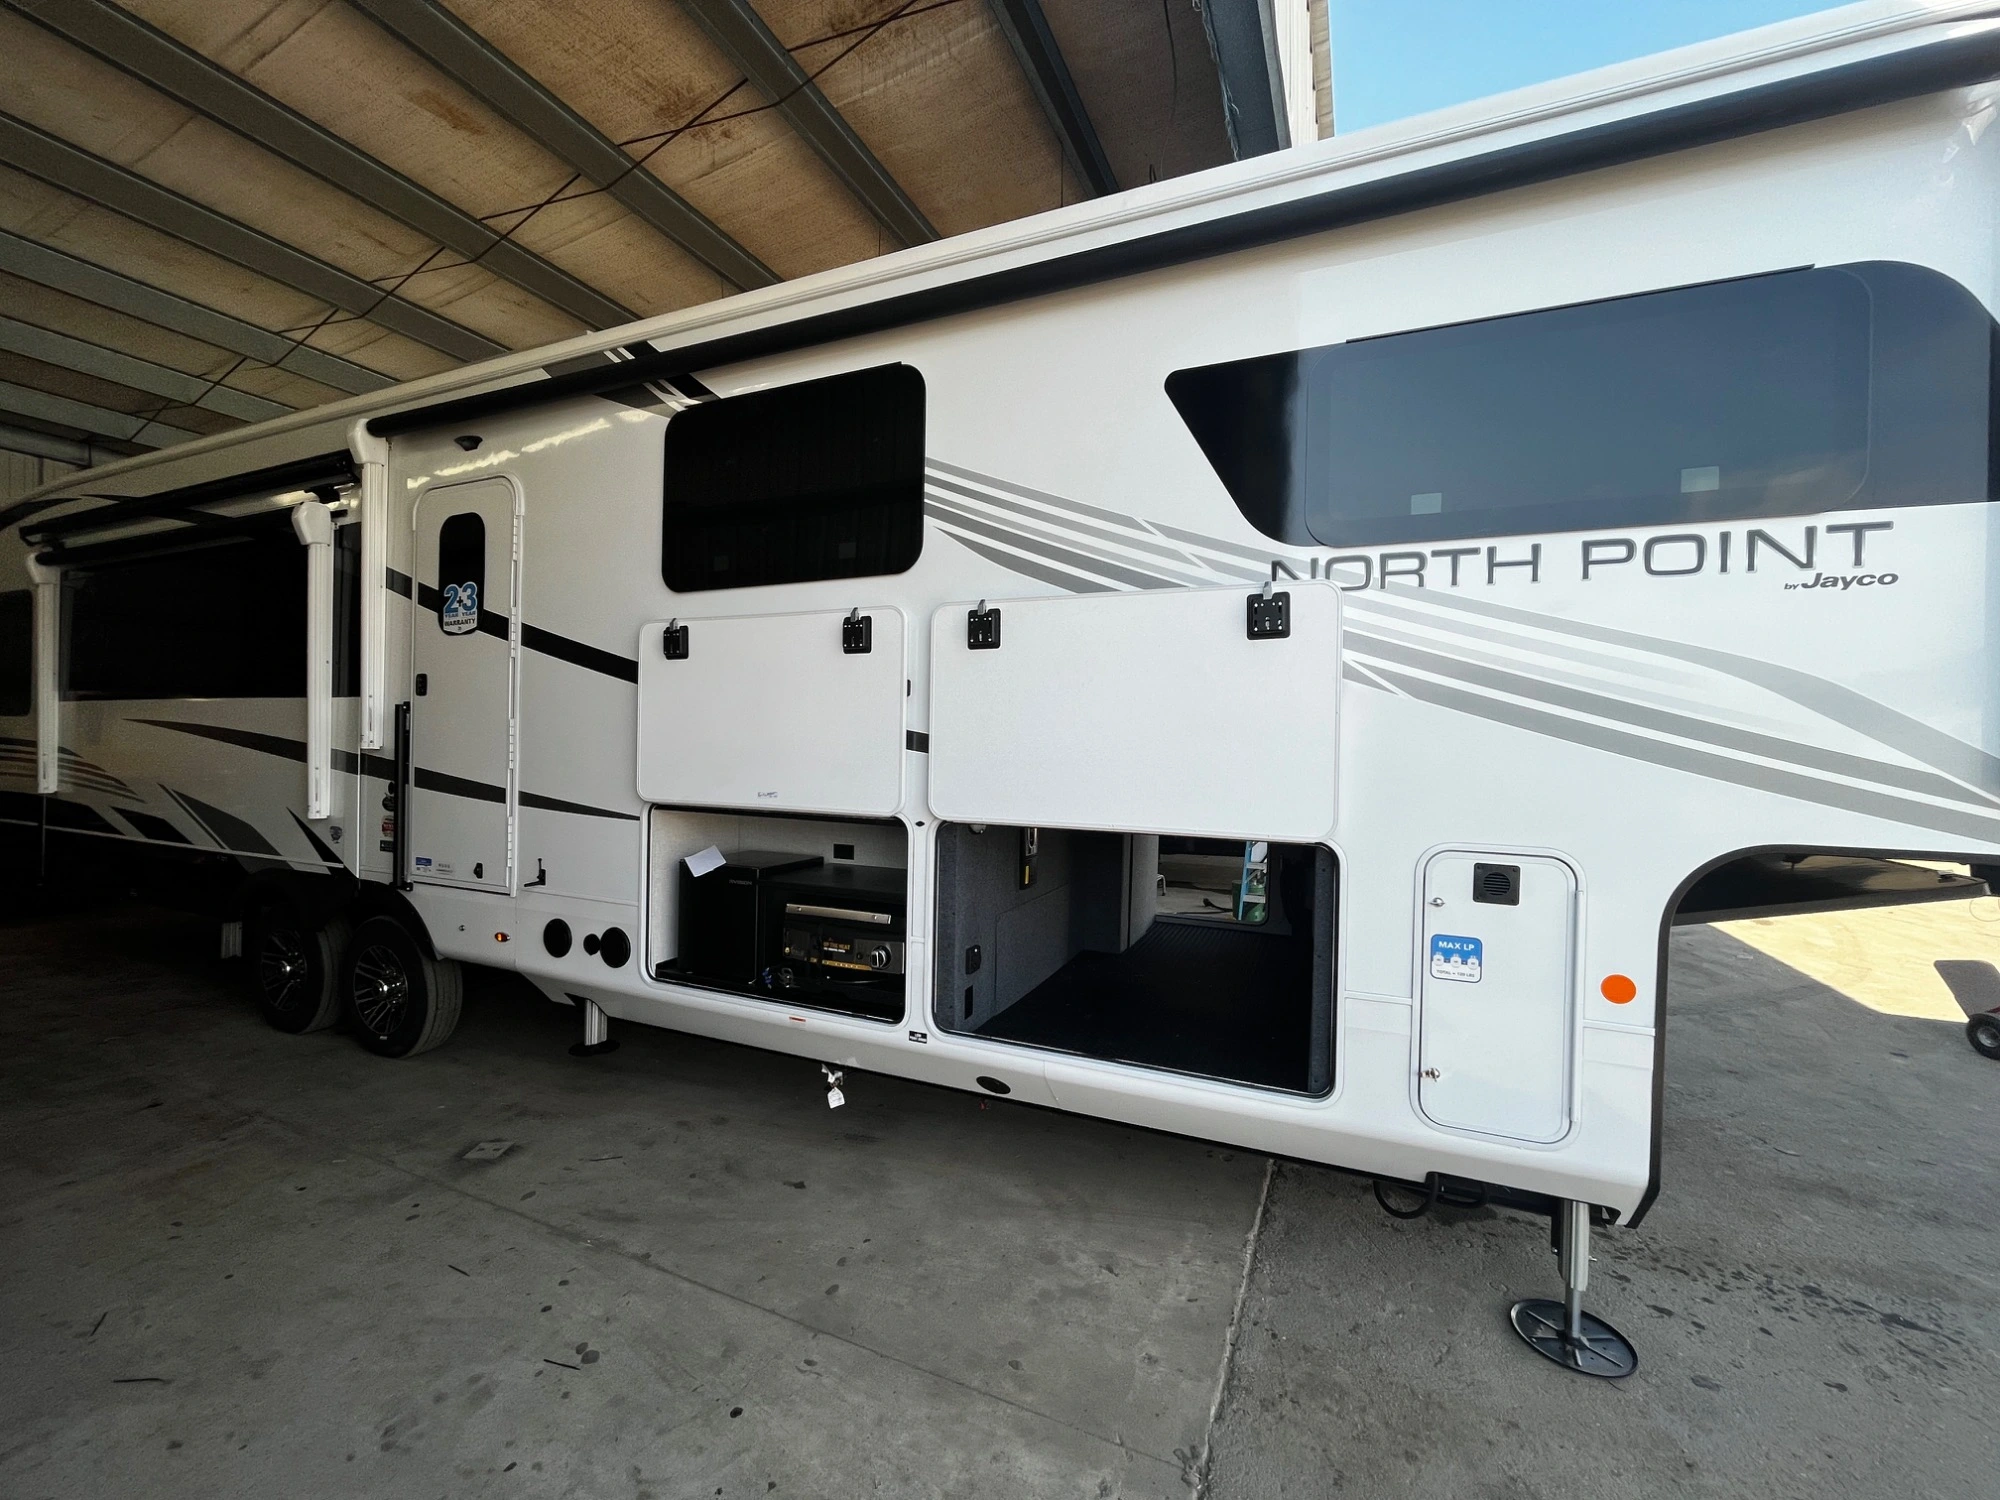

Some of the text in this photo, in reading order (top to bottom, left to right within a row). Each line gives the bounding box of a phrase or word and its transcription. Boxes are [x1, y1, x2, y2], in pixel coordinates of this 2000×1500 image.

[1271, 520, 1895, 592] NORTH POINT
[1784, 572, 1899, 591] by Jayco
[445, 618, 475, 626] WARRANTY
[1438, 941, 1475, 951] MAX LP
